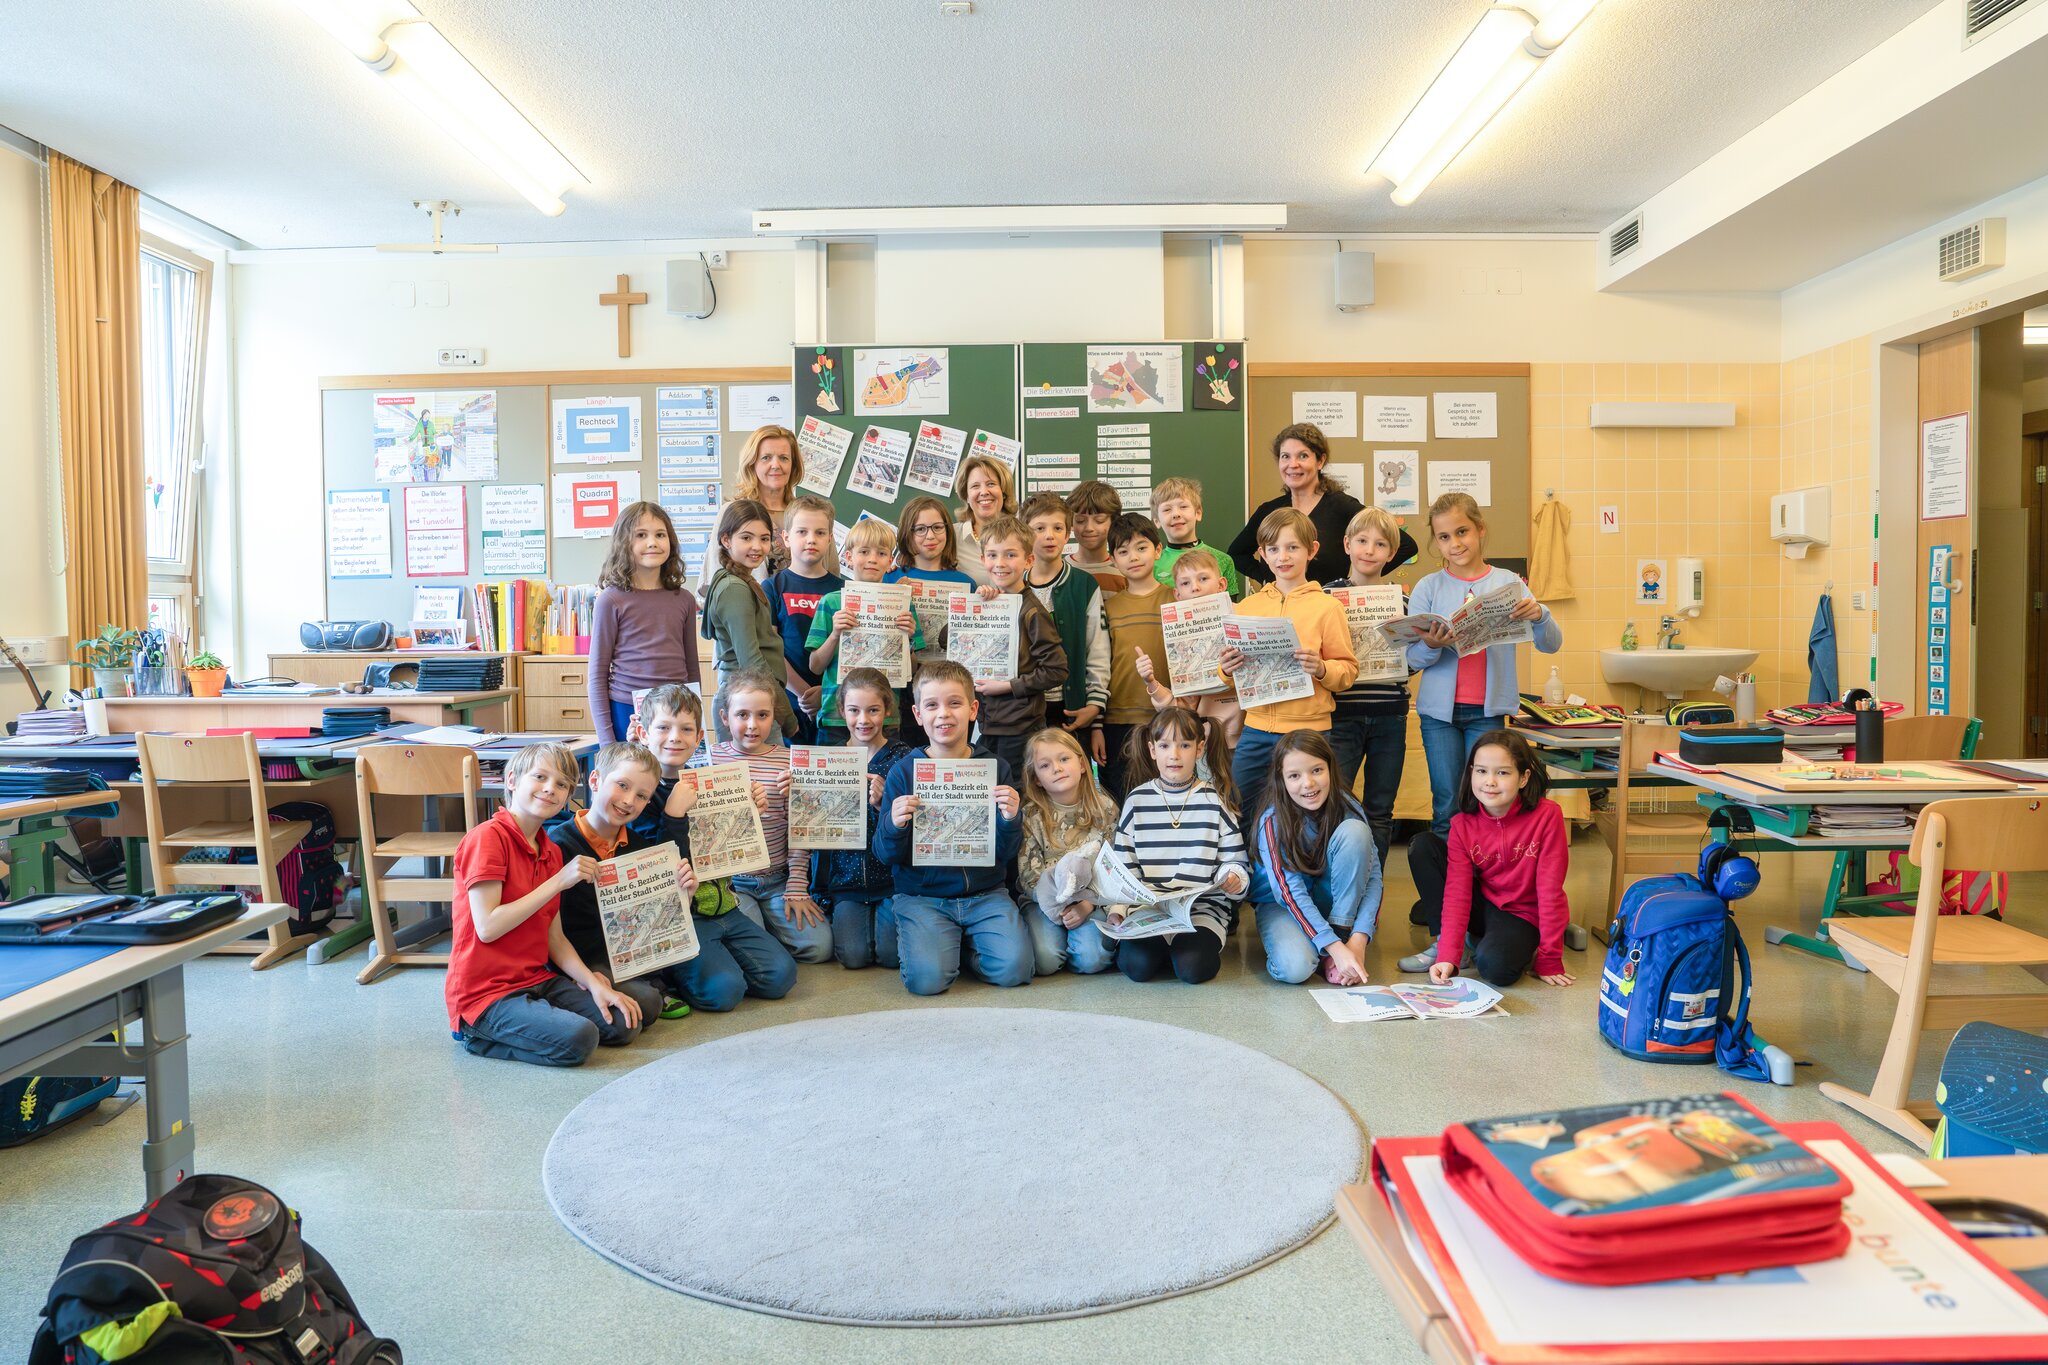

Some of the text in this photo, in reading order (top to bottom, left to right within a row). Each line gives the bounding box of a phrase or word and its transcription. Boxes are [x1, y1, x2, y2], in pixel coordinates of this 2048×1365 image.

[1108, 452, 1136, 460] Meidling
[580, 490, 611, 498] Quadrat
[1604, 512, 1614, 524] N
[502, 540, 523, 549] windig
[522, 552, 544, 560] sonnig
[485, 561, 543, 573] regnerisch wolkig
[790, 598, 818, 609] Lev
[1192, 617, 1212, 625] Bezirk
[714, 788, 734, 797] Bezirk
[698, 800, 708, 808] der
[727, 795, 748, 803] wurde
[1114, 866, 1122, 876] Hier
[600, 888, 612, 897] Als
[614, 884, 627, 894] der
[638, 874, 660, 887] Bezirk
[661, 870, 673, 878] ein
[601, 879, 675, 906] Teil der Stadt wurde
[1858, 1234, 1958, 1310] bunte
[261, 1262, 304, 1302] ergobag
